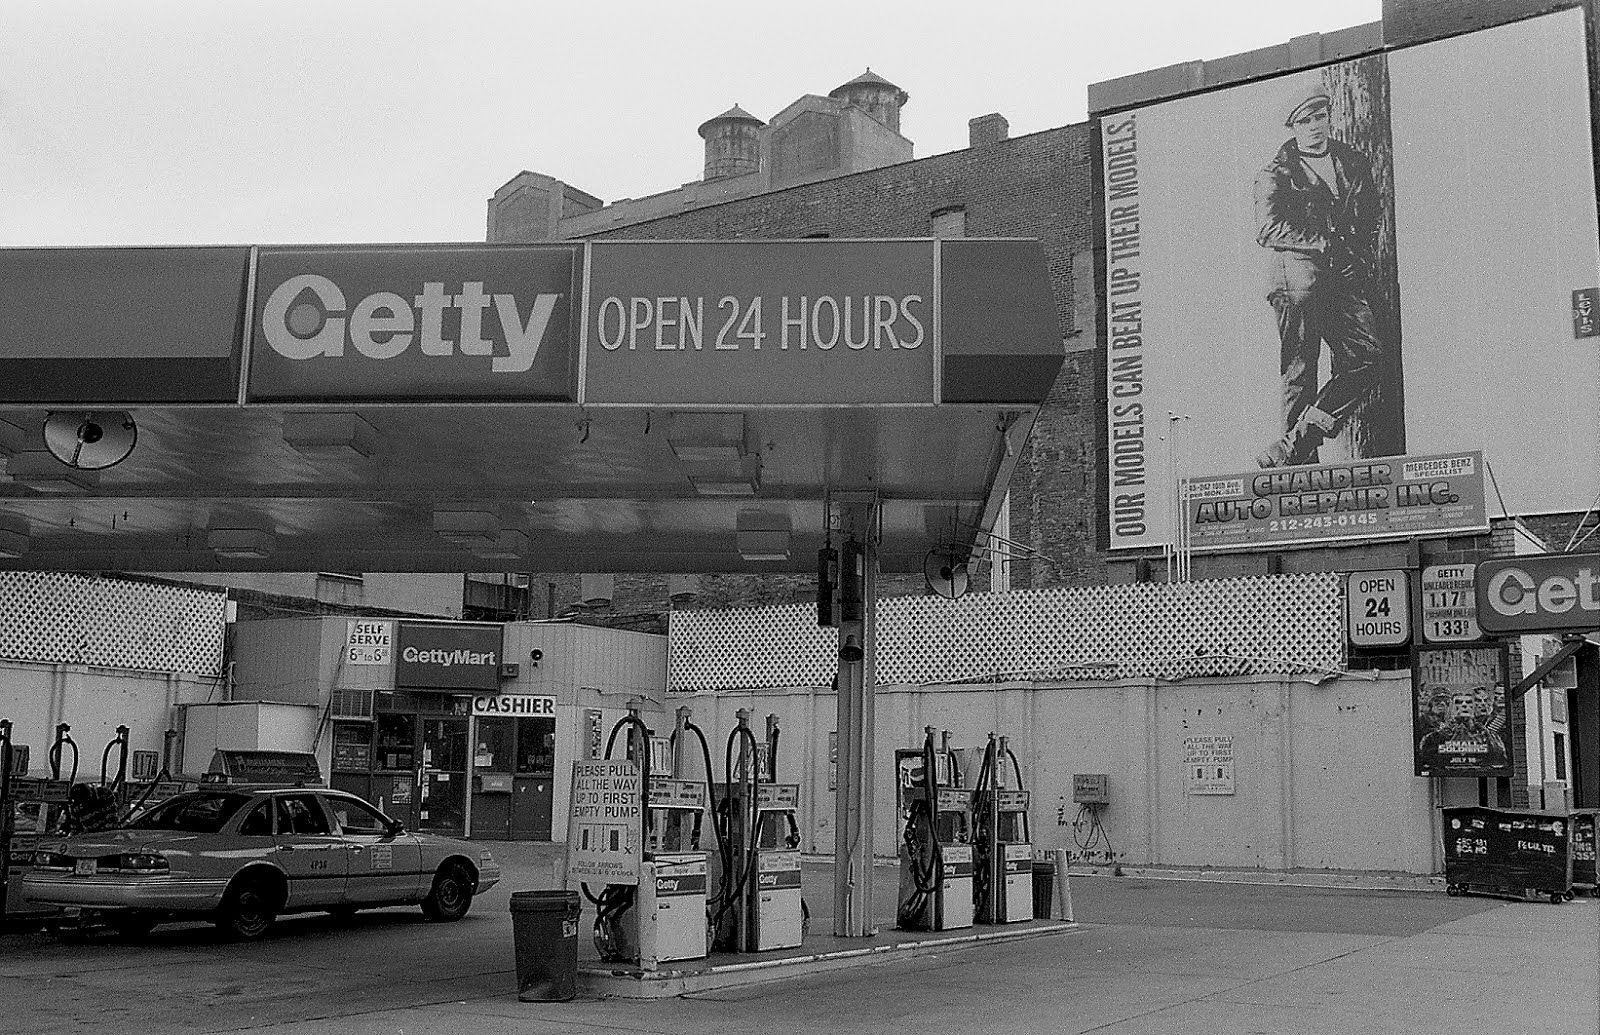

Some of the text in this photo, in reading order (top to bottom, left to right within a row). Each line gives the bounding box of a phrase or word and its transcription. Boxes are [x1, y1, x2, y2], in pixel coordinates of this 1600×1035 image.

[262, 274, 559, 373] Getty
[597, 294, 926, 351] OPEN 24 HOURS
[1107, 114, 1147, 537] OUR MODELS CAN BEAT UP THEIR MODELS.
[1405, 458, 1471, 472] MERCEDES BENZ
[1414, 467, 1463, 478] SPECIALIST
[1253, 463, 1393, 497] CHANDER
[1196, 497, 1273, 524] AUTO
[1279, 487, 1390, 517] REPAIR
[1396, 481, 1460, 508] INC.
[1438, 568, 1465, 578] GETTY
[1359, 579, 1395, 593] OPEN
[1365, 597, 1391, 618] 24
[356, 624, 384, 634] SELF
[1356, 622, 1402, 637] HOURS
[349, 634, 390, 645] SERVE
[402, 646, 496, 667] GettyMart
[474, 696, 554, 714] CASHIER
[576, 765, 638, 777] PLEASE PULL
[576, 779, 637, 790] ALL THE WAY
[576, 792, 636, 804] UP TO FIRST
[573, 806, 600, 817] EMPTY
[656, 877, 679, 892] Getty
